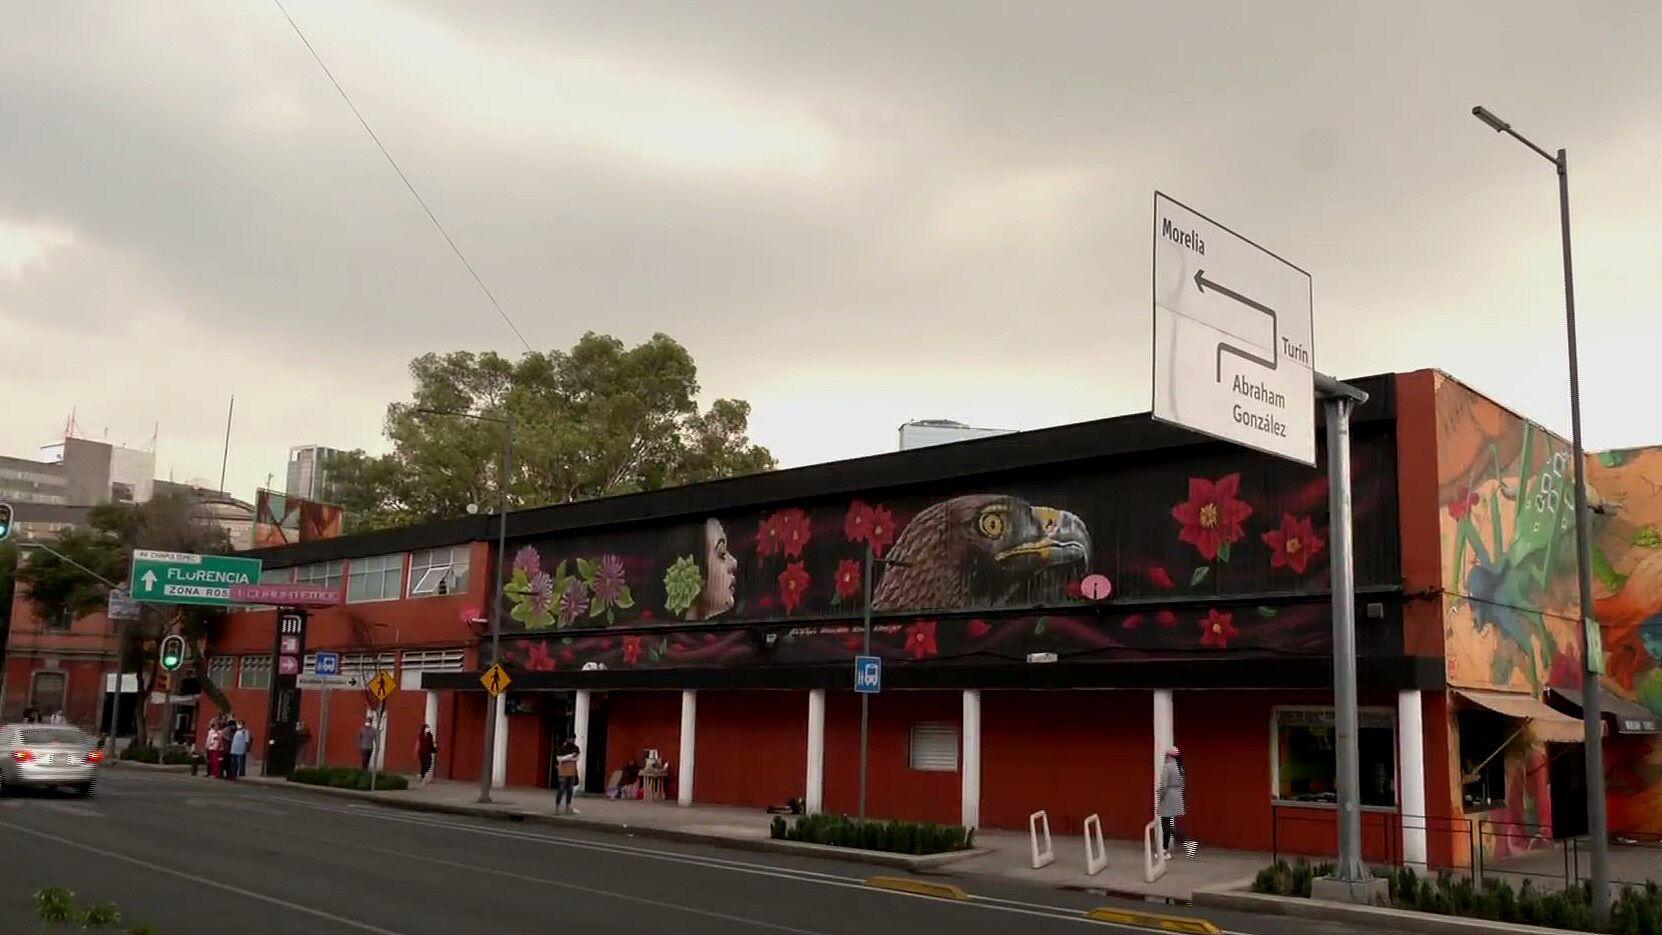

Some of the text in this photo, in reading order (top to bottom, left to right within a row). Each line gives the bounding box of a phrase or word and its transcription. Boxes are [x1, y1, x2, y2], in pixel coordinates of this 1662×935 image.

[1162, 217, 1205, 255] Morelia
[1282, 336, 1309, 364] Turín
[1232, 374, 1285, 409] Abraham
[1233, 404, 1287, 437] González
[167, 567, 250, 584] FLORENCIA
[169, 586, 200, 596] ZONA
[206, 588, 229, 598] ROS
